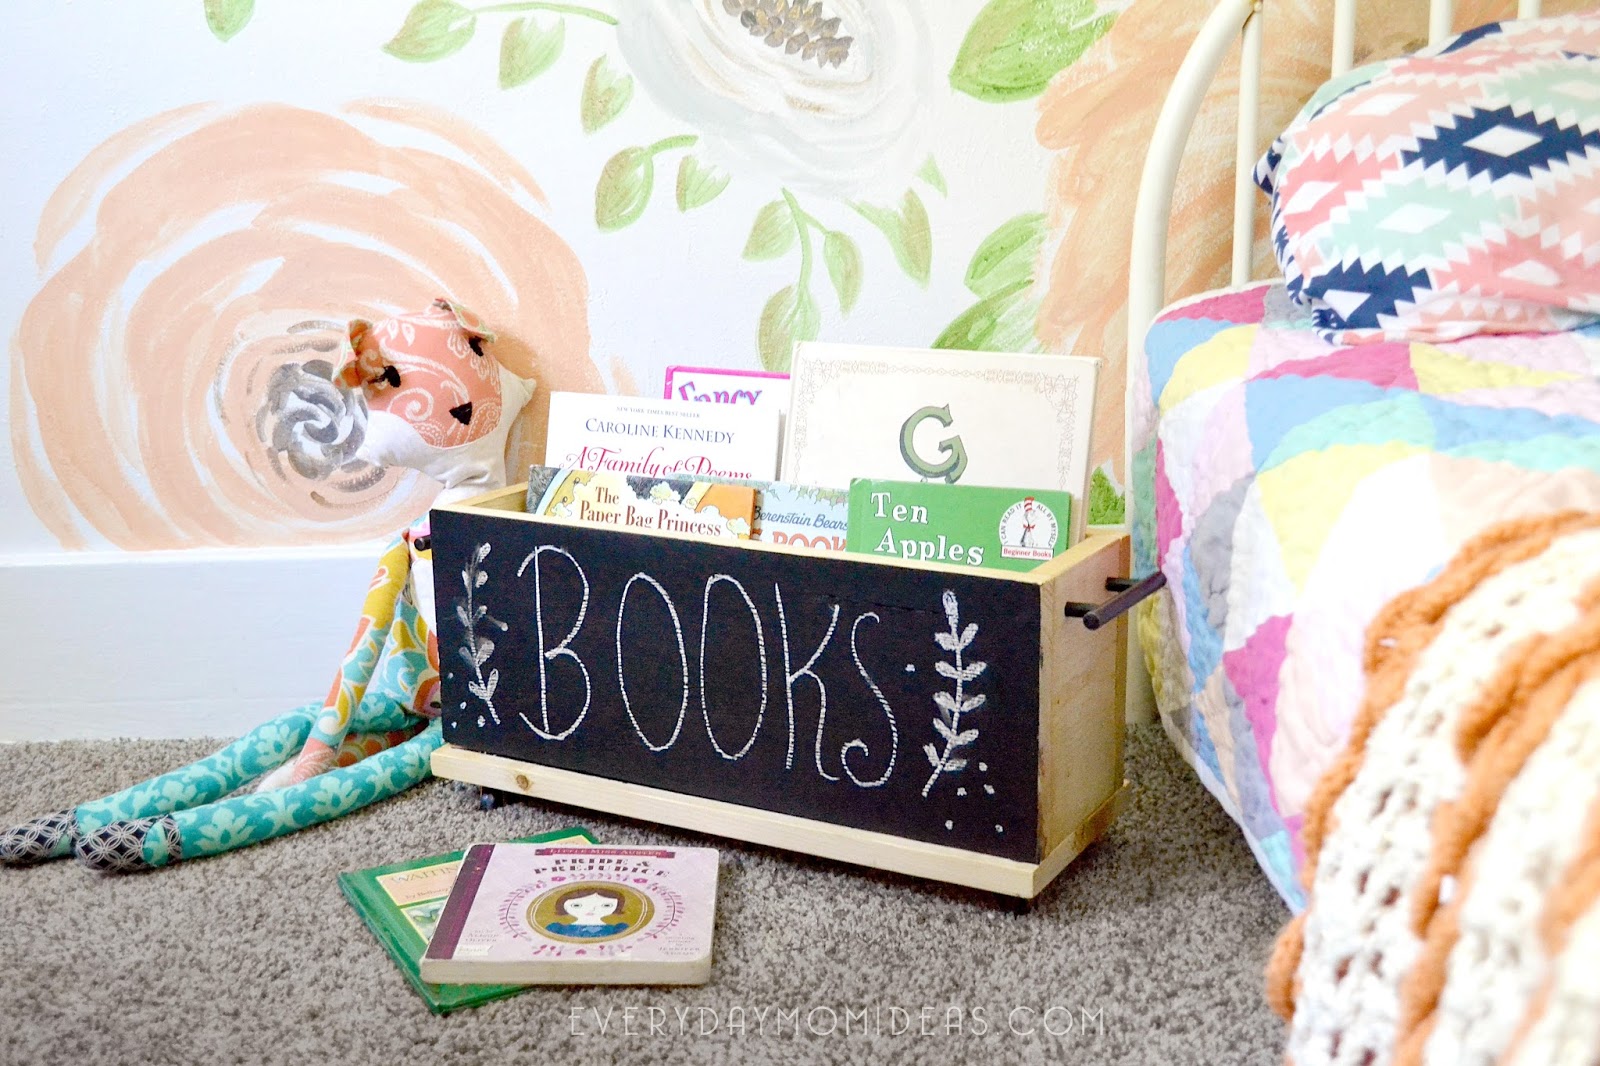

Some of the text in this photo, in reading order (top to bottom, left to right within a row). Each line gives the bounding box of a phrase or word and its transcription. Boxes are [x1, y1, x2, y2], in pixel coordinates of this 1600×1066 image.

[585, 417, 735, 444] CAROLINE KENNEDY
[899, 403, 969, 484] G
[587, 446, 665, 479] Family
[662, 461, 684, 476] of
[595, 486, 620, 505] The
[870, 492, 929, 525] Ten
[579, 500, 722, 537] Paper Bag Princess
[754, 505, 848, 531] Berenstain Bears
[873, 526, 985, 567] Apples
[1003, 547, 1052, 559] Beginner Books
[516, 544, 899, 788] BOOKS
[534, 864, 672, 878] PREJUDICE
[555, 857, 629, 866] PRIDE
